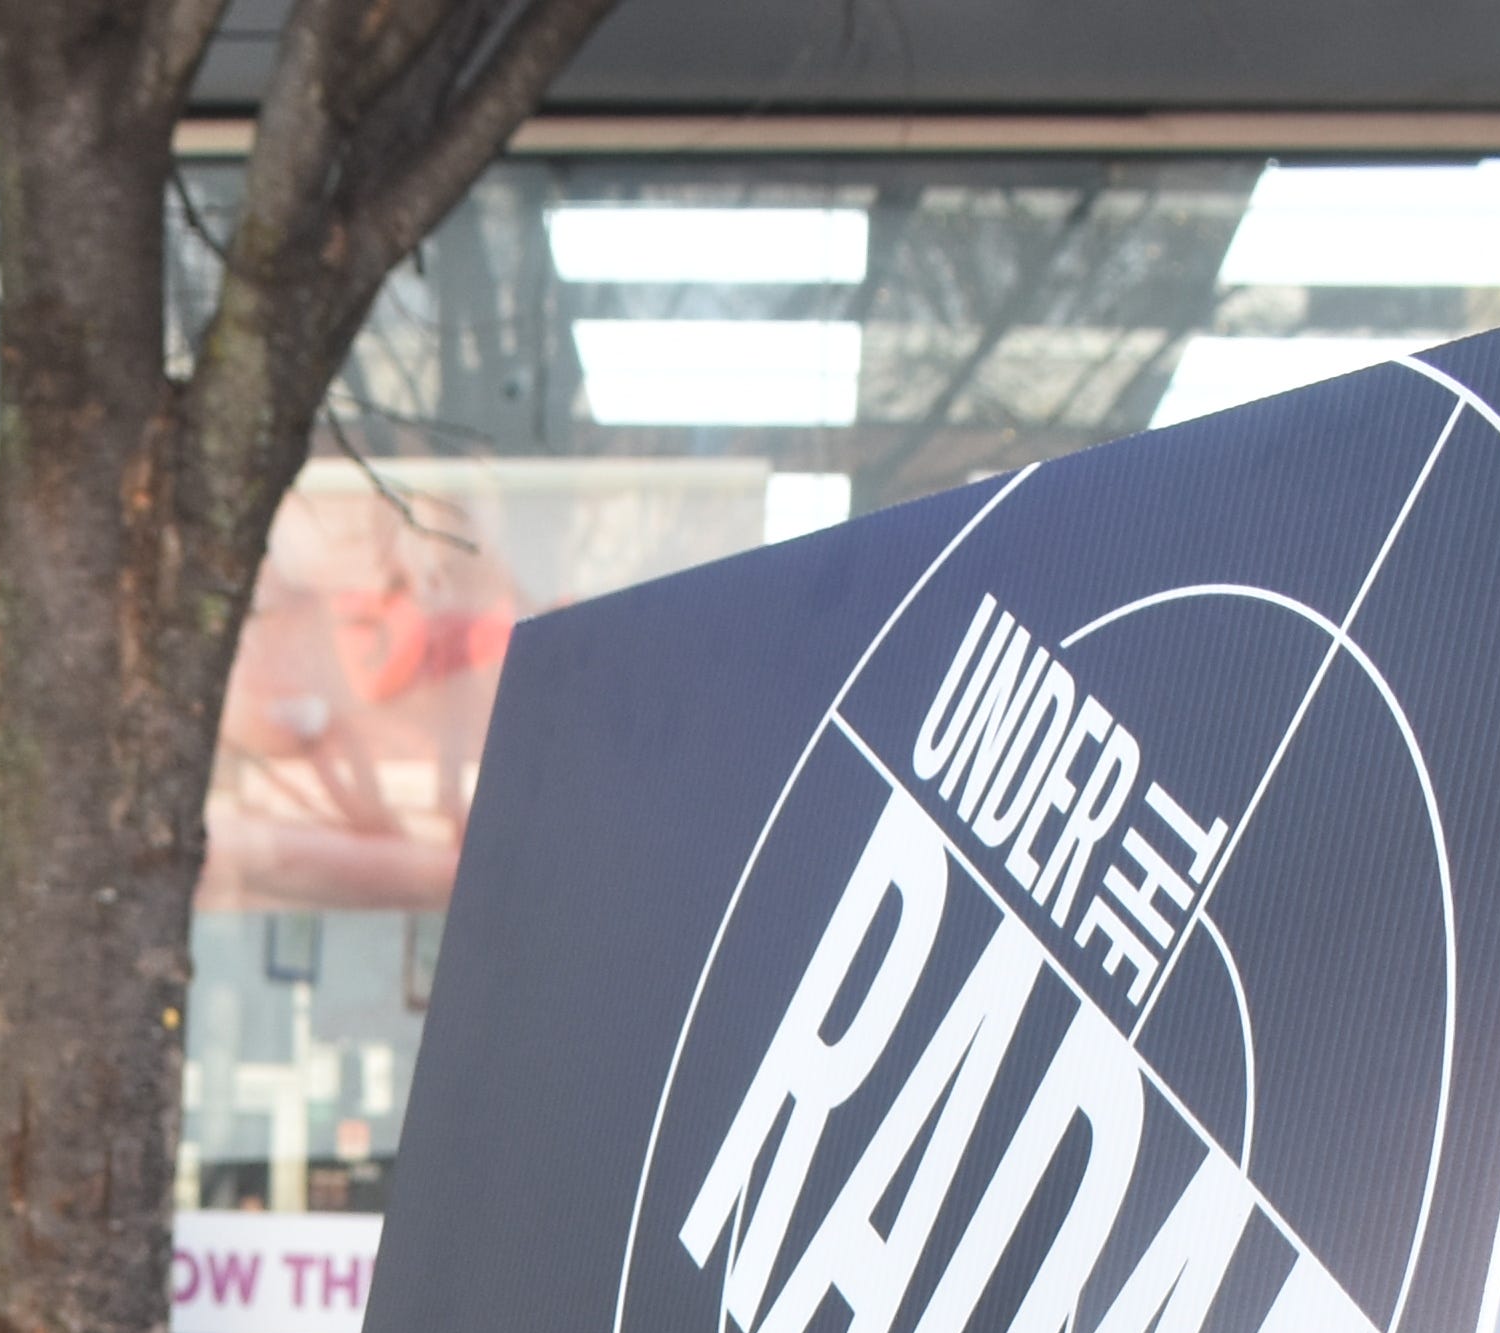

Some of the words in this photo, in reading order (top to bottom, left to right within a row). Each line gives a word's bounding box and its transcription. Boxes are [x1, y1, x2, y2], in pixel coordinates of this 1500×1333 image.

[912, 591, 1141, 930] UNDER
[1072, 780, 1230, 1008] THE
[283, 1252, 379, 1308] TH
